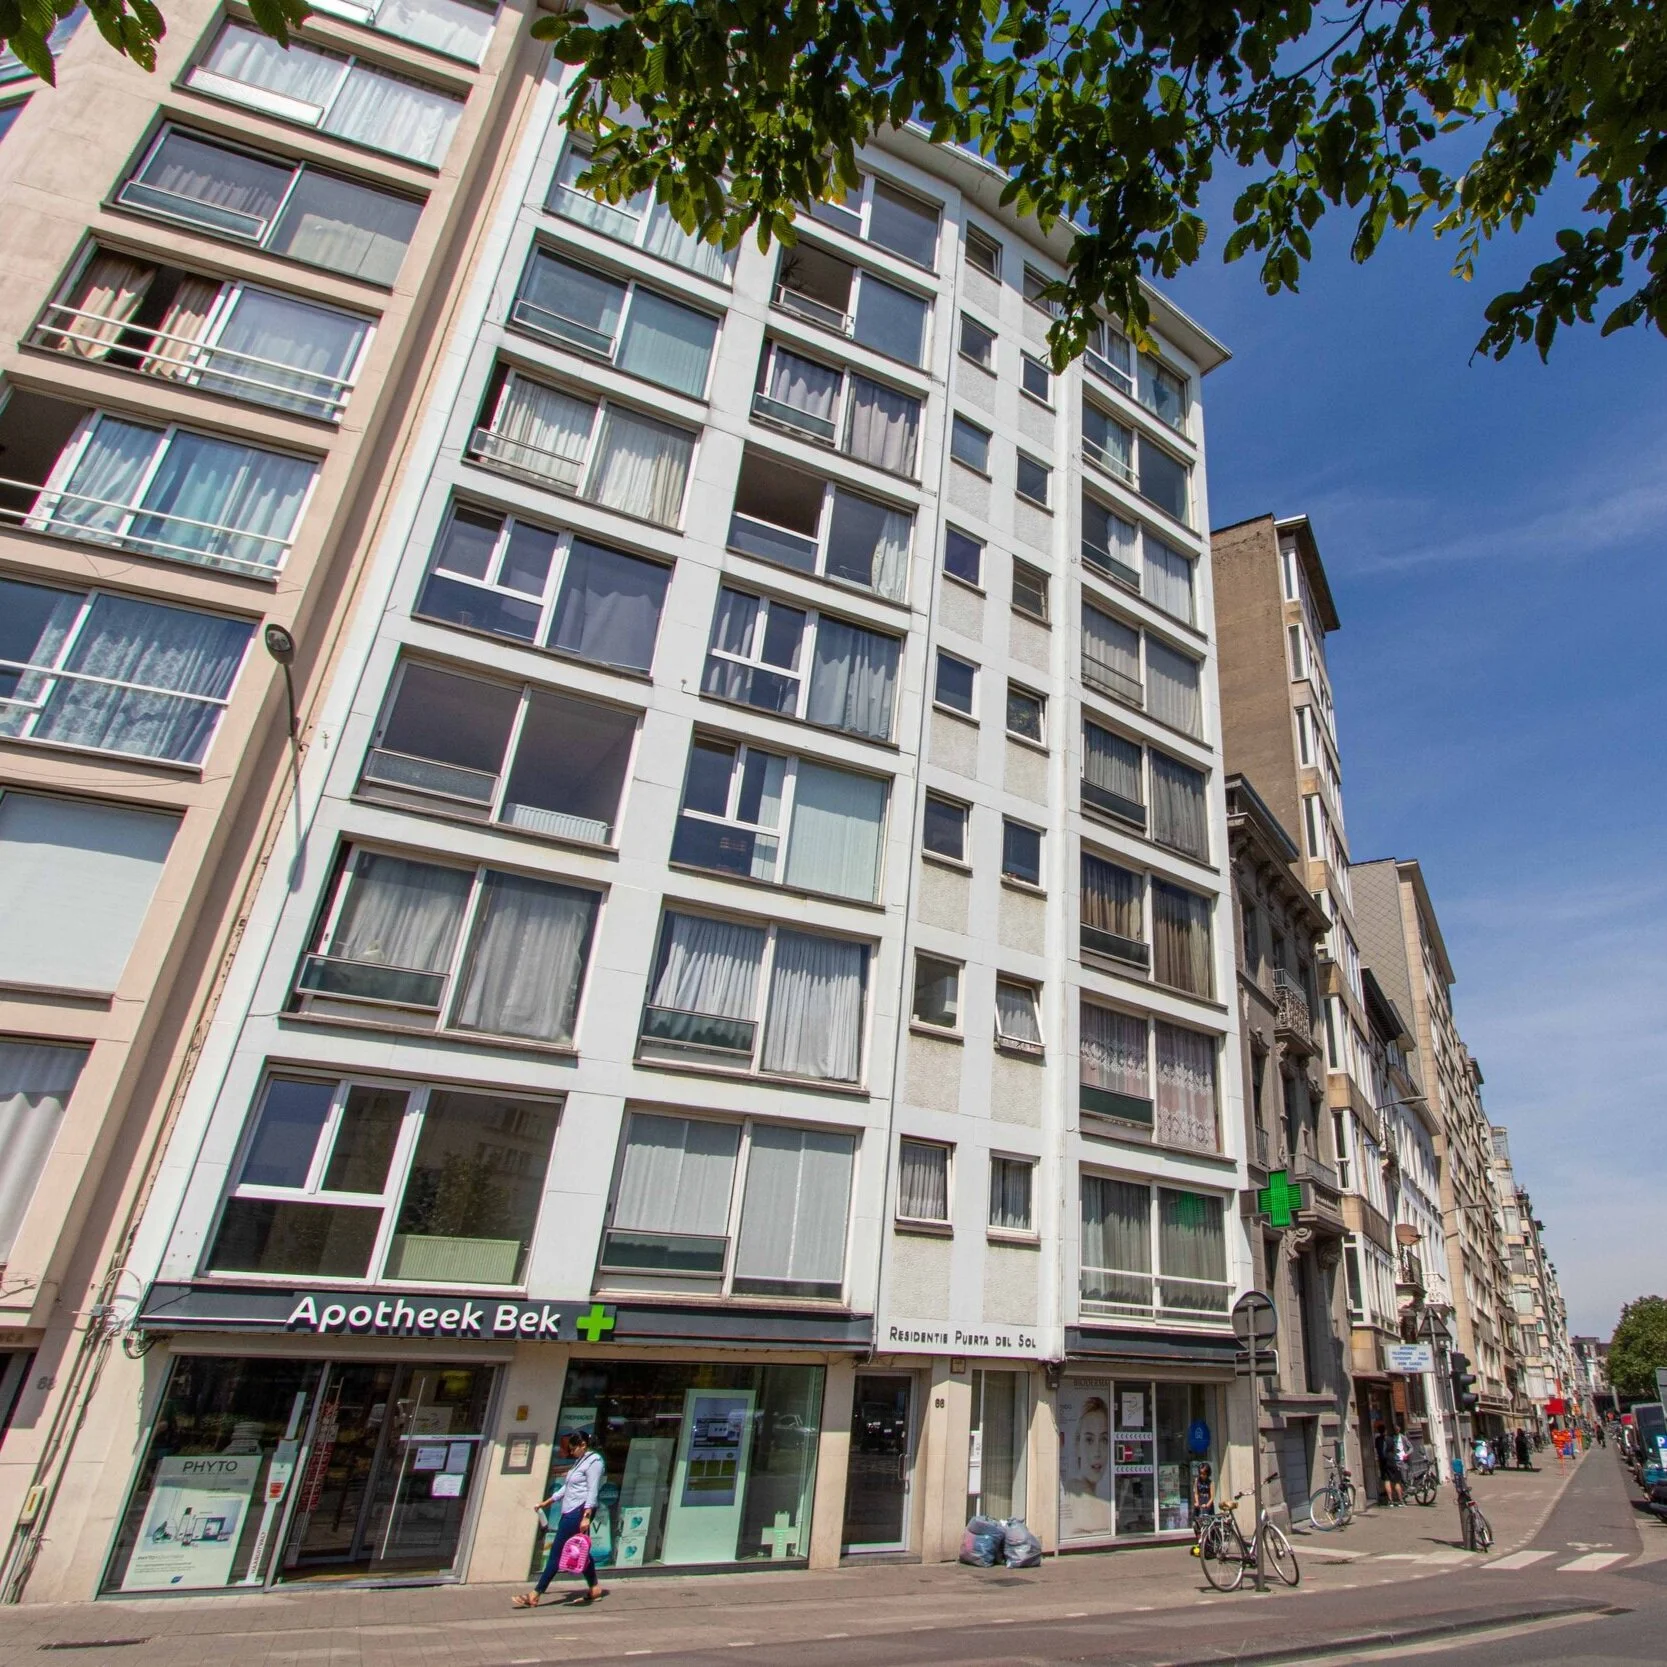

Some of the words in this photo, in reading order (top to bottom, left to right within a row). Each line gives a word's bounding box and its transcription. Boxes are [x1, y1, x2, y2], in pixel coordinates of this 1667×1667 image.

[286, 1296, 484, 1333] Apotheek
[493, 1305, 561, 1333] Bek
[1018, 1334, 1036, 1348] SOL
[1657, 1436, 1666, 1448] P
[182, 1460, 238, 1472] PHYTO
